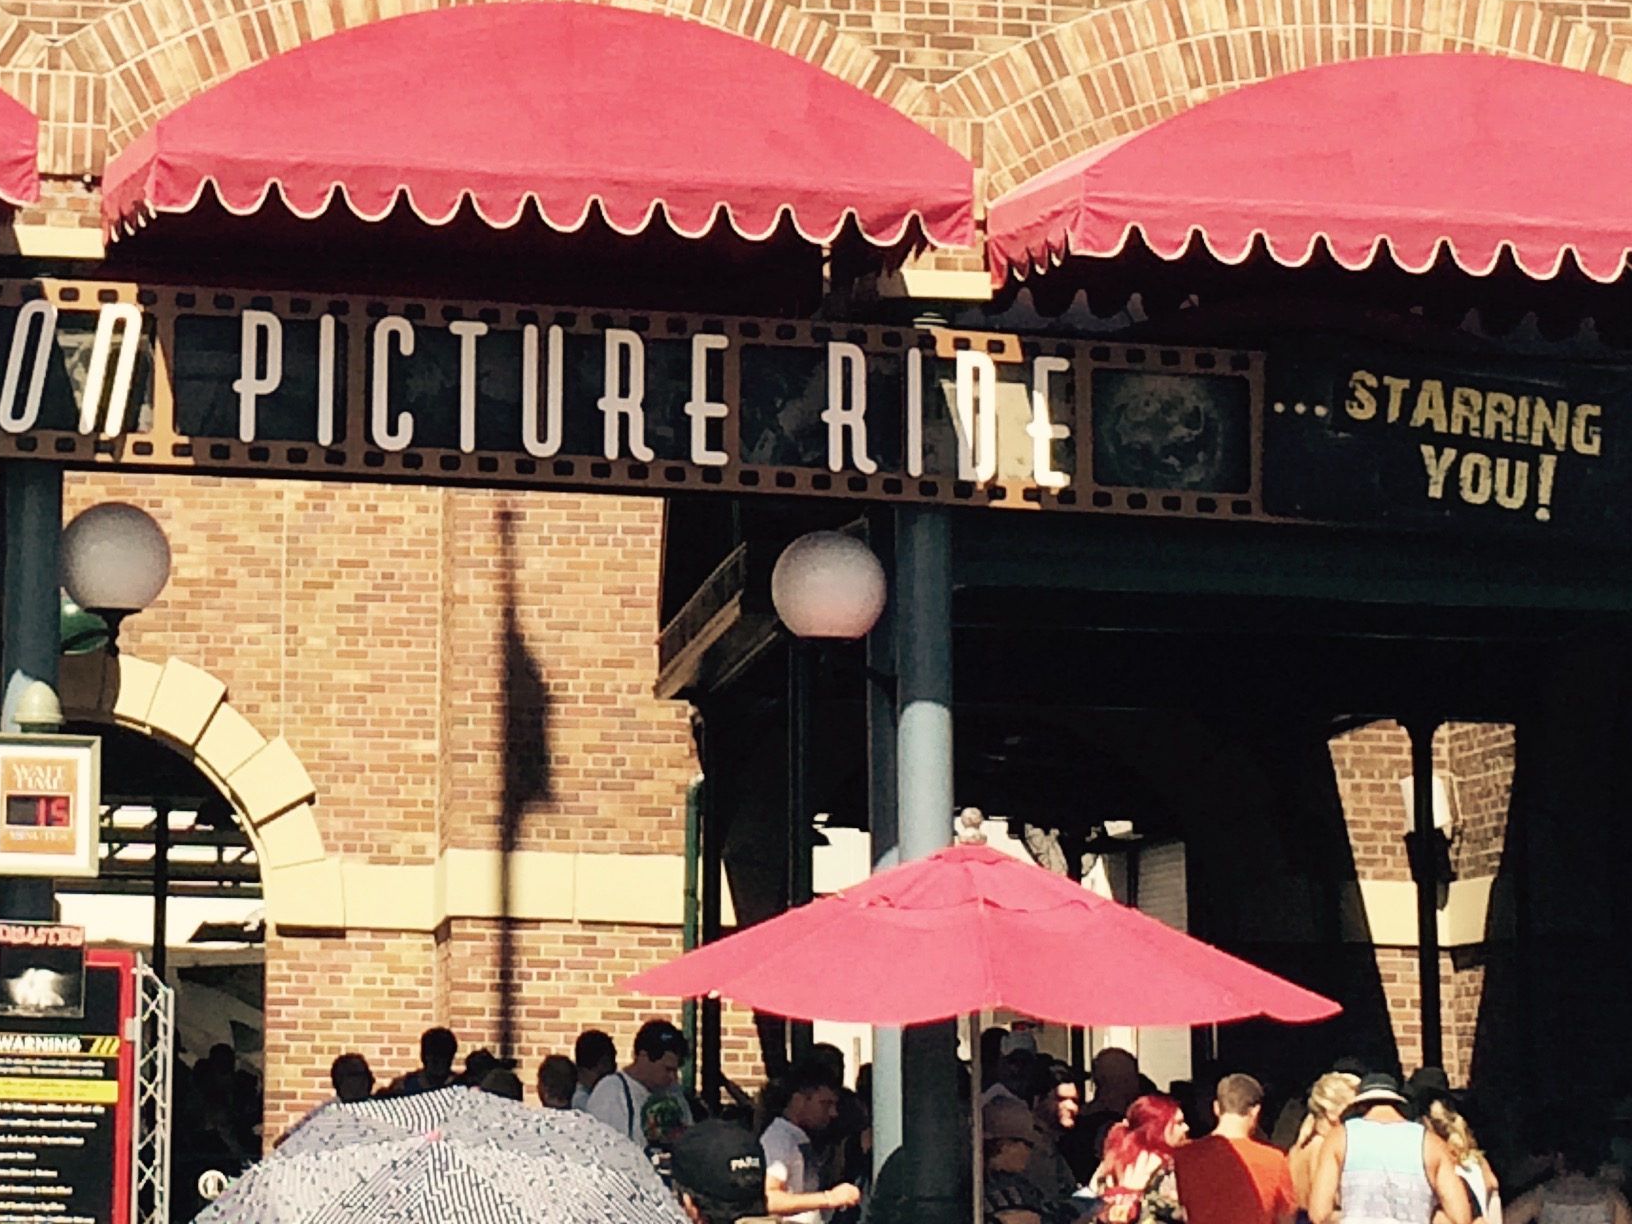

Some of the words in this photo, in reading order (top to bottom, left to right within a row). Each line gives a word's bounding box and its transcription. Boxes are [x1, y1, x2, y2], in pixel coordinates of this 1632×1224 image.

[232, 309, 731, 467] PICTURE
[820, 340, 1071, 489] RIDE
[1419, 443, 1558, 522] YOU!
[35, 797, 70, 827] 15
